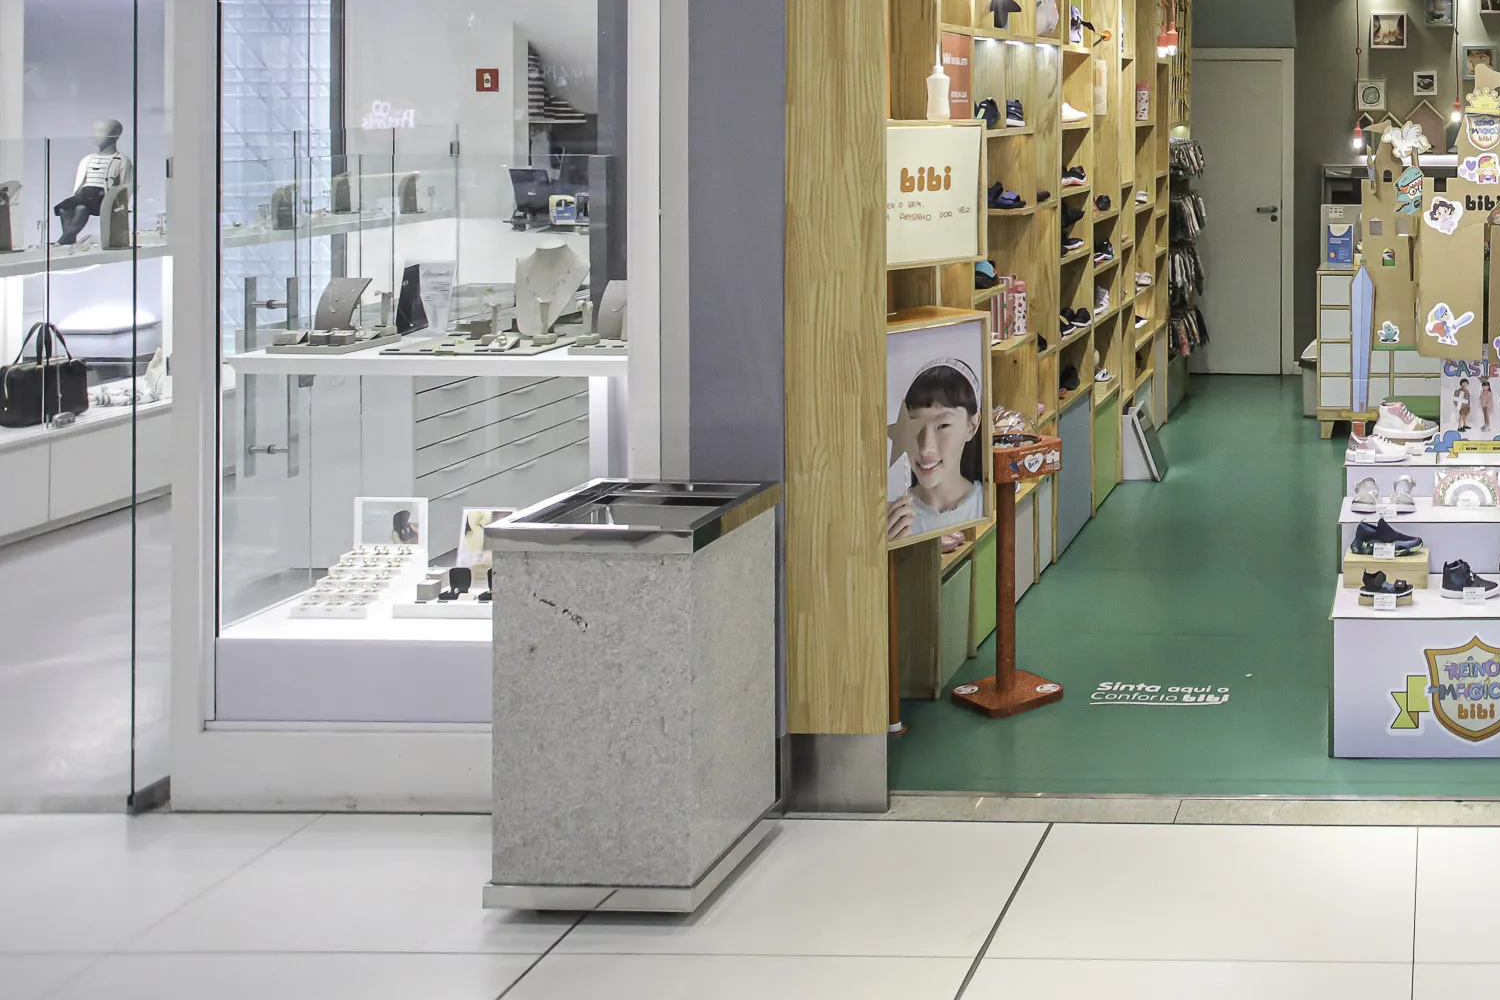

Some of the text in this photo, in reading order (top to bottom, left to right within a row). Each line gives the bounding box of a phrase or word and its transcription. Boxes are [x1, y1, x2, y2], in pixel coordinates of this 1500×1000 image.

[899, 165, 952, 193] bibi
[1097, 682, 1162, 692] Sinta
[1167, 685, 1212, 694] aqui
[1090, 691, 1230, 703] Conforto bibi
[1457, 703, 1495, 719] bibi
